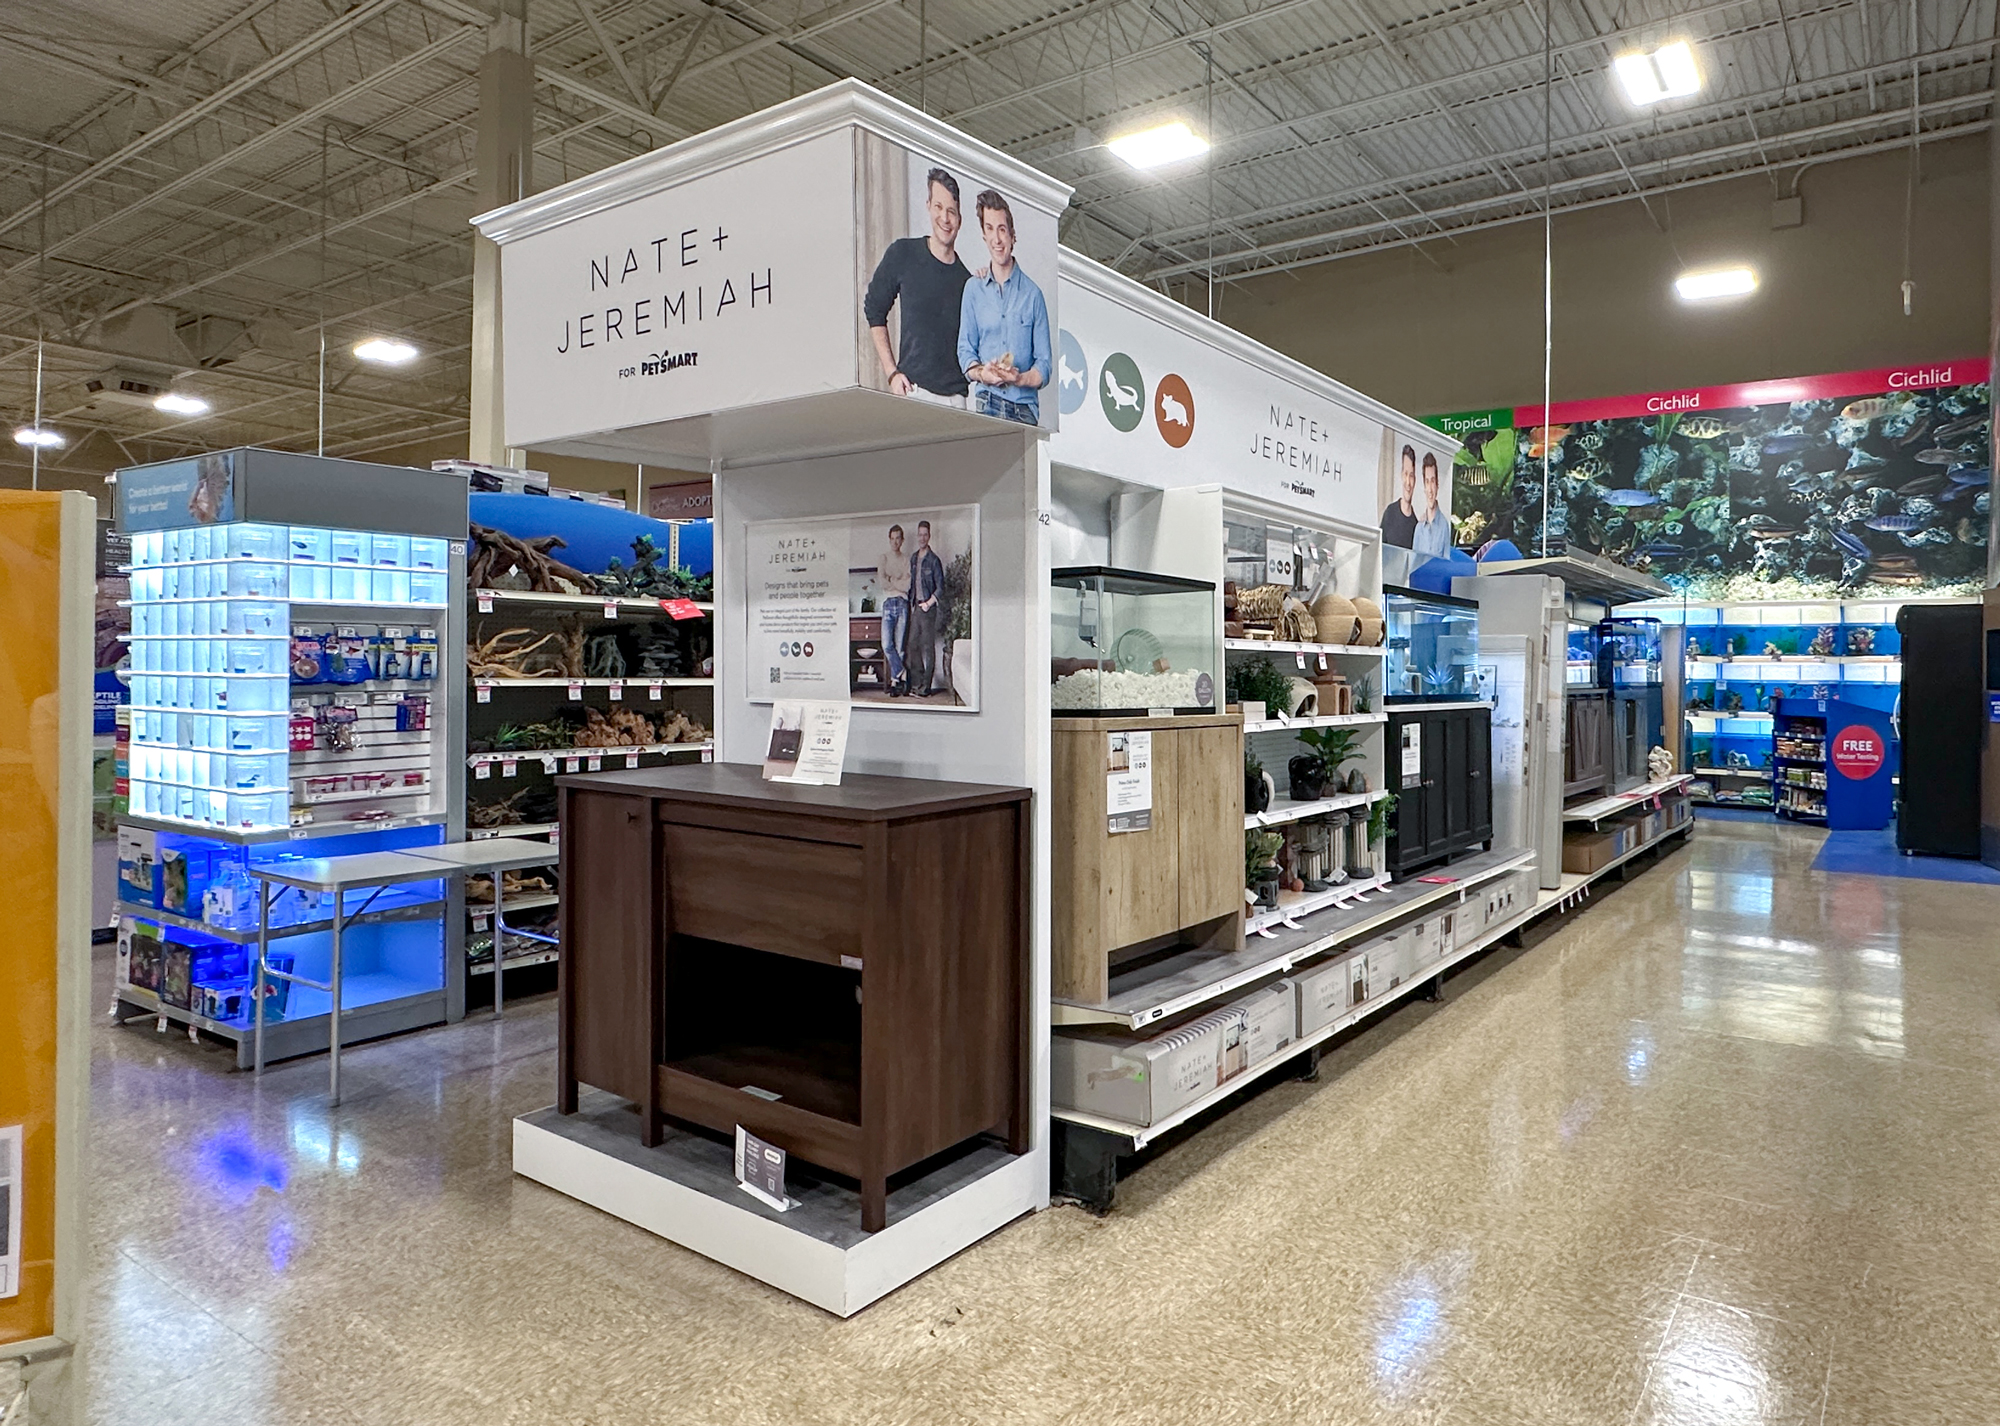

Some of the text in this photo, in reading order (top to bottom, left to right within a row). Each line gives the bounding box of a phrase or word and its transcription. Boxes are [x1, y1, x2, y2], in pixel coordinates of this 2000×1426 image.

[590, 226, 728, 291] NATE+
[557, 268, 772, 354] JEREMIAH
[619, 366, 636, 380] FOR
[1887, 366, 1952, 388] Cichlid
[1646, 392, 1700, 412] Cichlid
[1270, 403, 1328, 443] NATE+
[1440, 414, 1492, 433] Tropical
[1250, 433, 1342, 482] JEREMIAH
[1281, 481, 1290, 490] FOR
[682, 495, 713, 508] ADOPT
[1038, 513, 1050, 526] 42
[778, 537, 816, 549] NATE+
[450, 545, 464, 555] 40
[768, 551, 826, 564] JEREMIAH
[764, 580, 830, 591] Designs that bring pets
[768, 591, 827, 600] and people together
[1843, 740, 1873, 752] FREE
[1857, 753, 1879, 761] Testing
